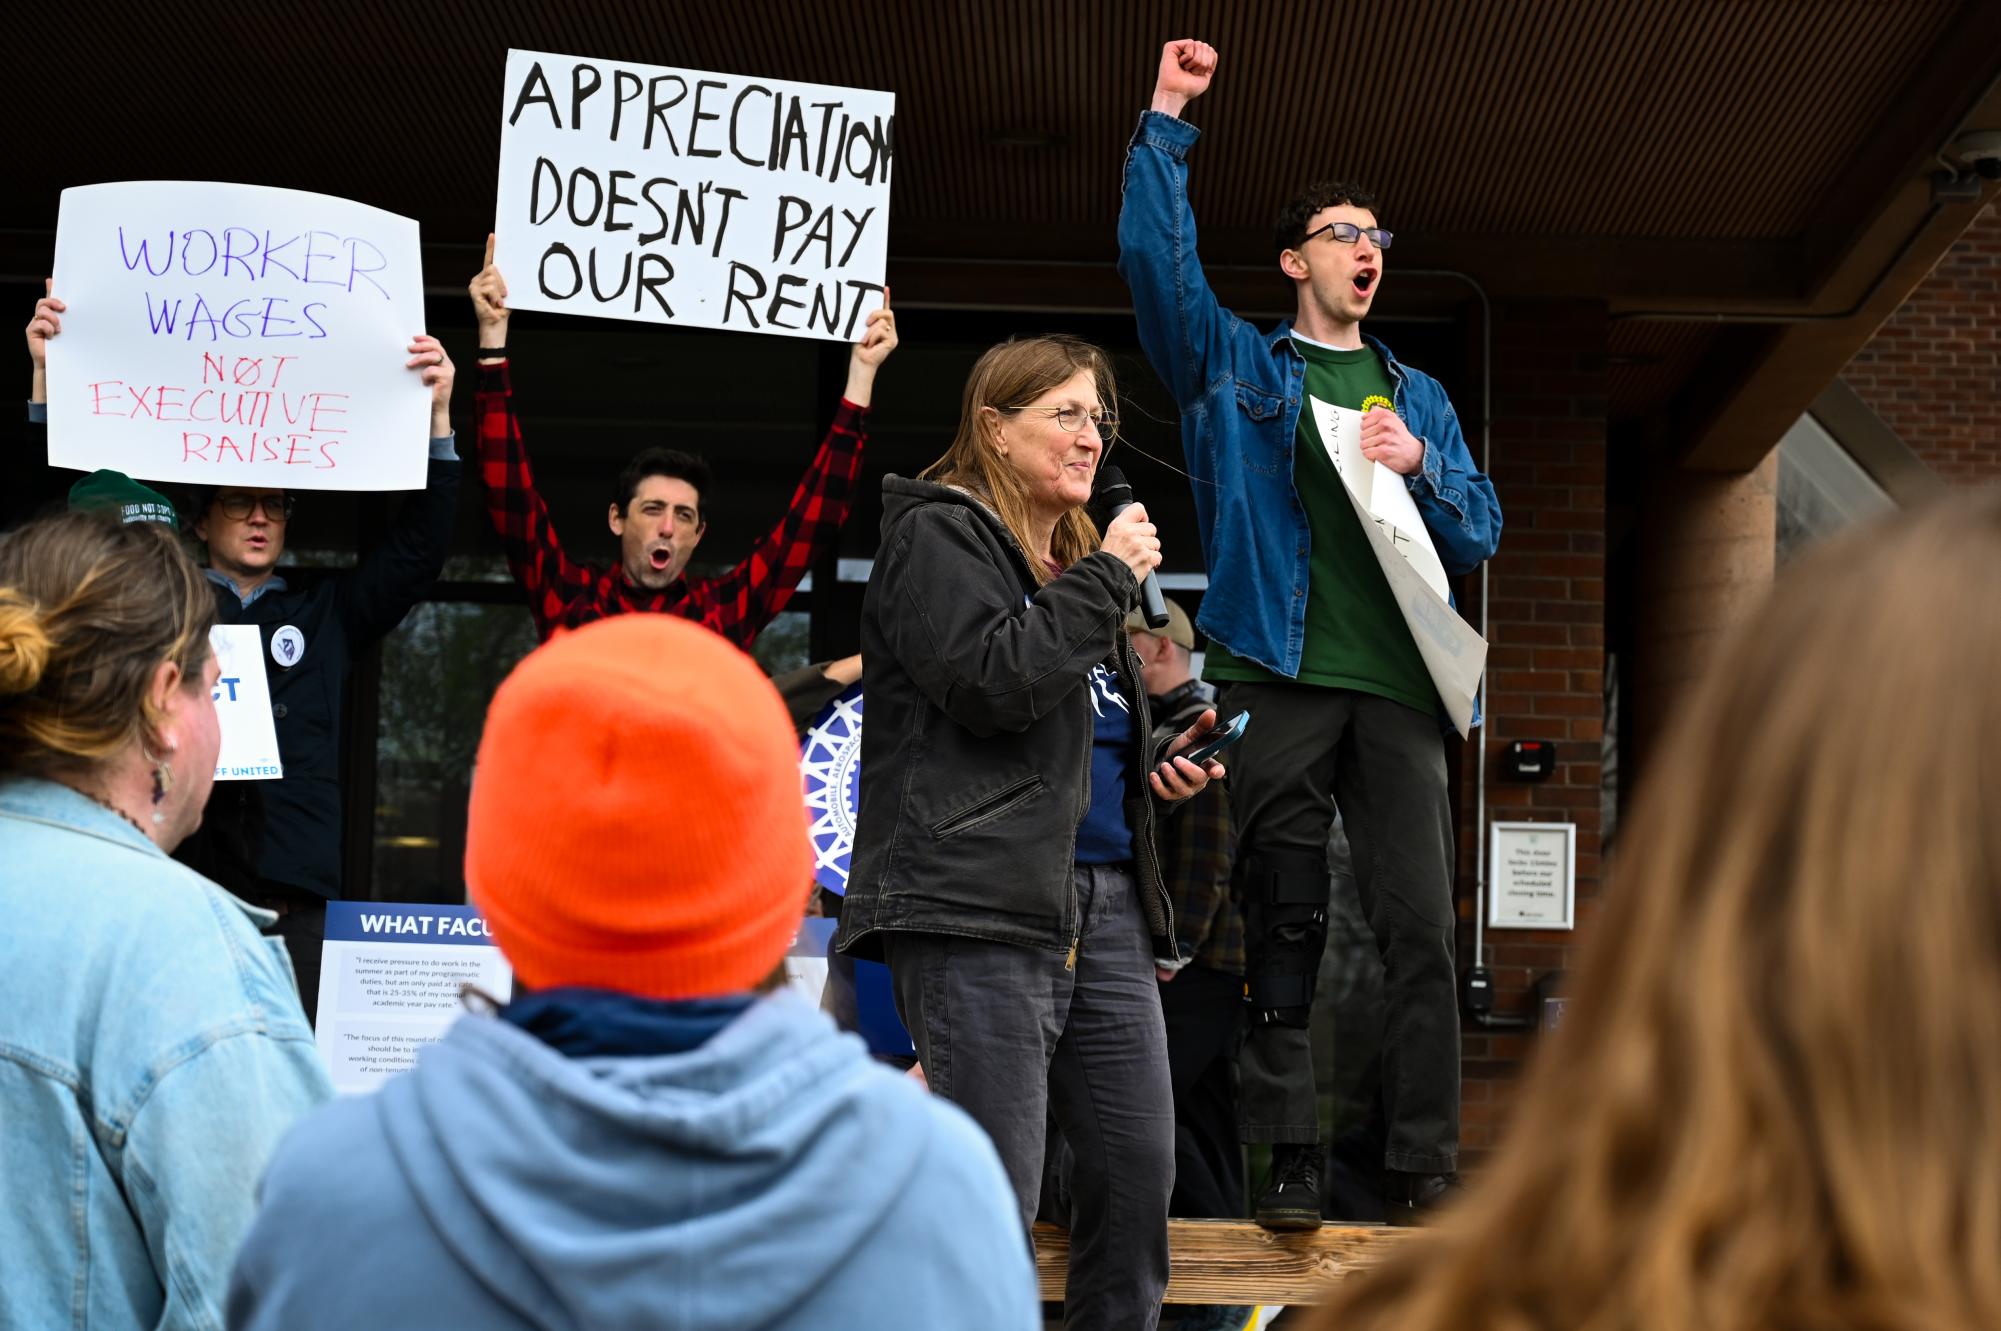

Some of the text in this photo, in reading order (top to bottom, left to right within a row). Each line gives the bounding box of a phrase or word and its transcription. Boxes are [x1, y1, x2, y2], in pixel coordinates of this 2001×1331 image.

[509, 61, 895, 186] APPRECIATION
[530, 156, 876, 269] DOESN'T PAY
[119, 226, 390, 300] WORKER
[538, 242, 887, 340] OUR RENT
[145, 292, 327, 341] WAGES
[88, 380, 349, 433] EXECUTIVE
[182, 432, 340, 469] RAISES
[142, 503, 155, 513] NOT
[231, 766, 279, 776] UNITED
[360, 914, 433, 934] WHAT
[390, 959, 420, 968] pressure
[394, 969, 408, 977] part
[419, 970, 430, 978] my
[432, 970, 480, 978] programmatic
[385, 978, 397, 986] but
[411, 979, 426, 988] only
[427, 980, 442, 988] paid
[366, 988, 381, 996] that
[419, 989, 427, 997] of
[372, 999, 404, 1007] academic
[407, 1000, 422, 1008] year
[361, 1033, 380, 1042] focus
[368, 1045, 391, 1053] should
[348, 1055, 377, 1064] working
